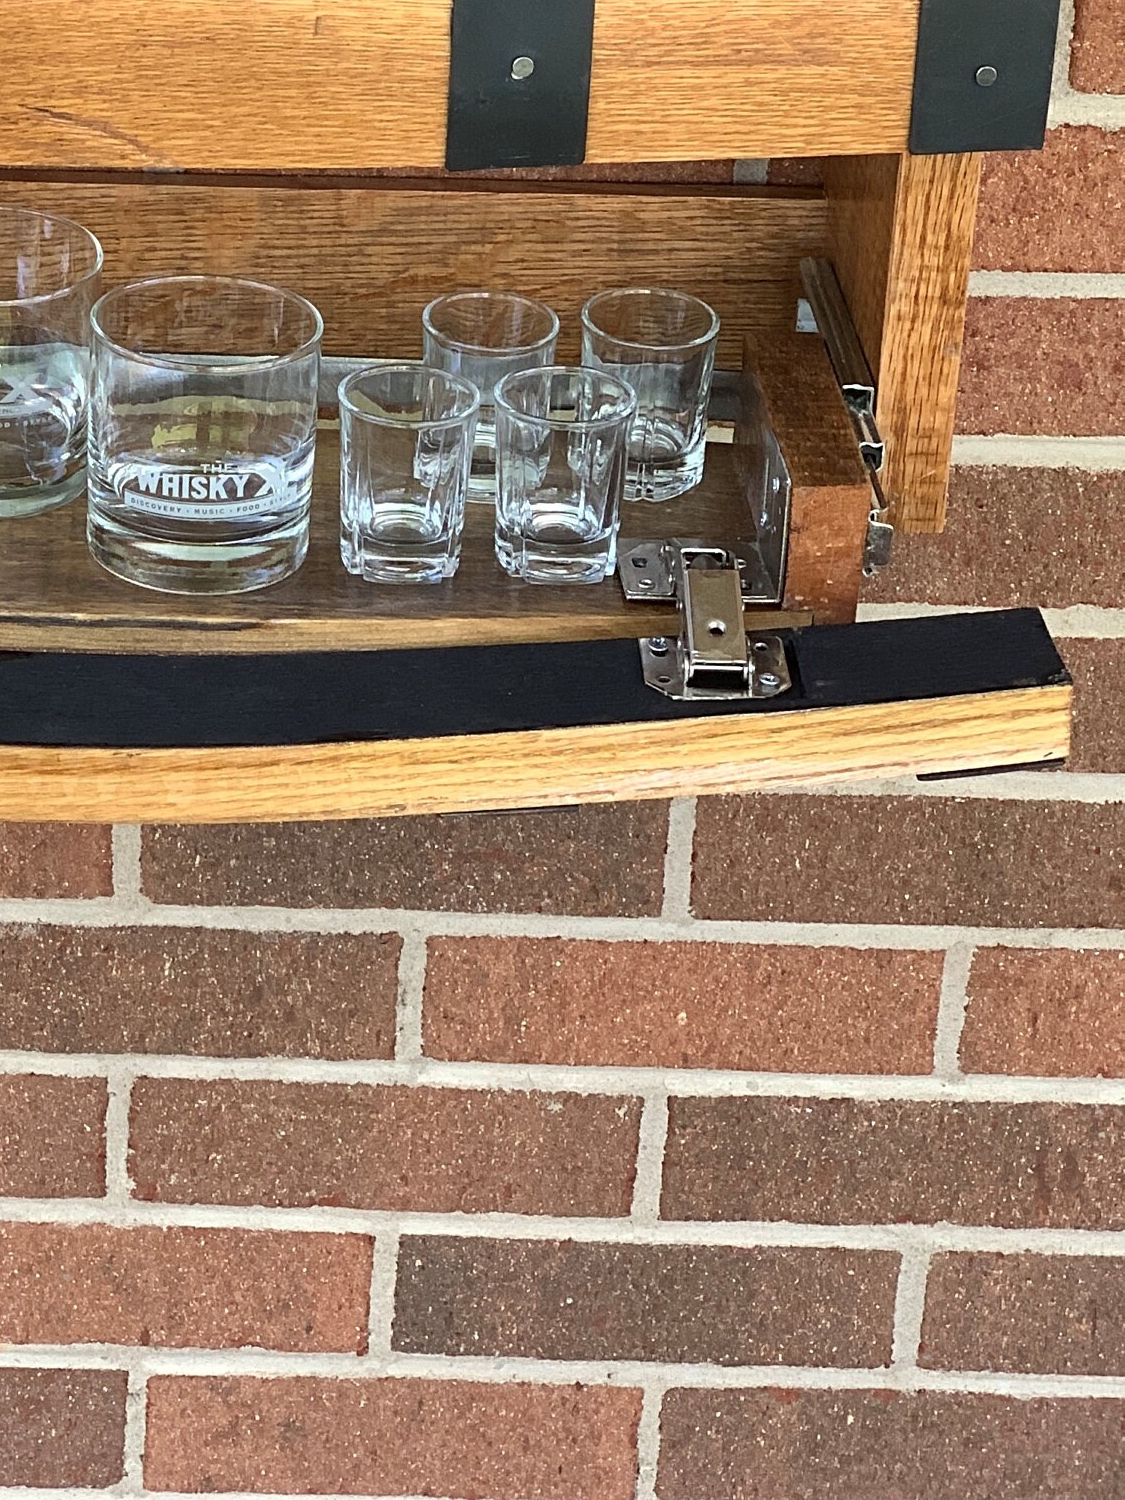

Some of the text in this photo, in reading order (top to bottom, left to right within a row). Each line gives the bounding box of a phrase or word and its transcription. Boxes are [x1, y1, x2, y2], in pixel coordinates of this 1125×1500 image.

[200, 463, 233, 474] THE
[136, 471, 251, 500] WHISKY
[130, 497, 182, 513] DISCOVERY
[194, 507, 226, 515] MUSIC
[236, 503, 261, 512] FOOD
